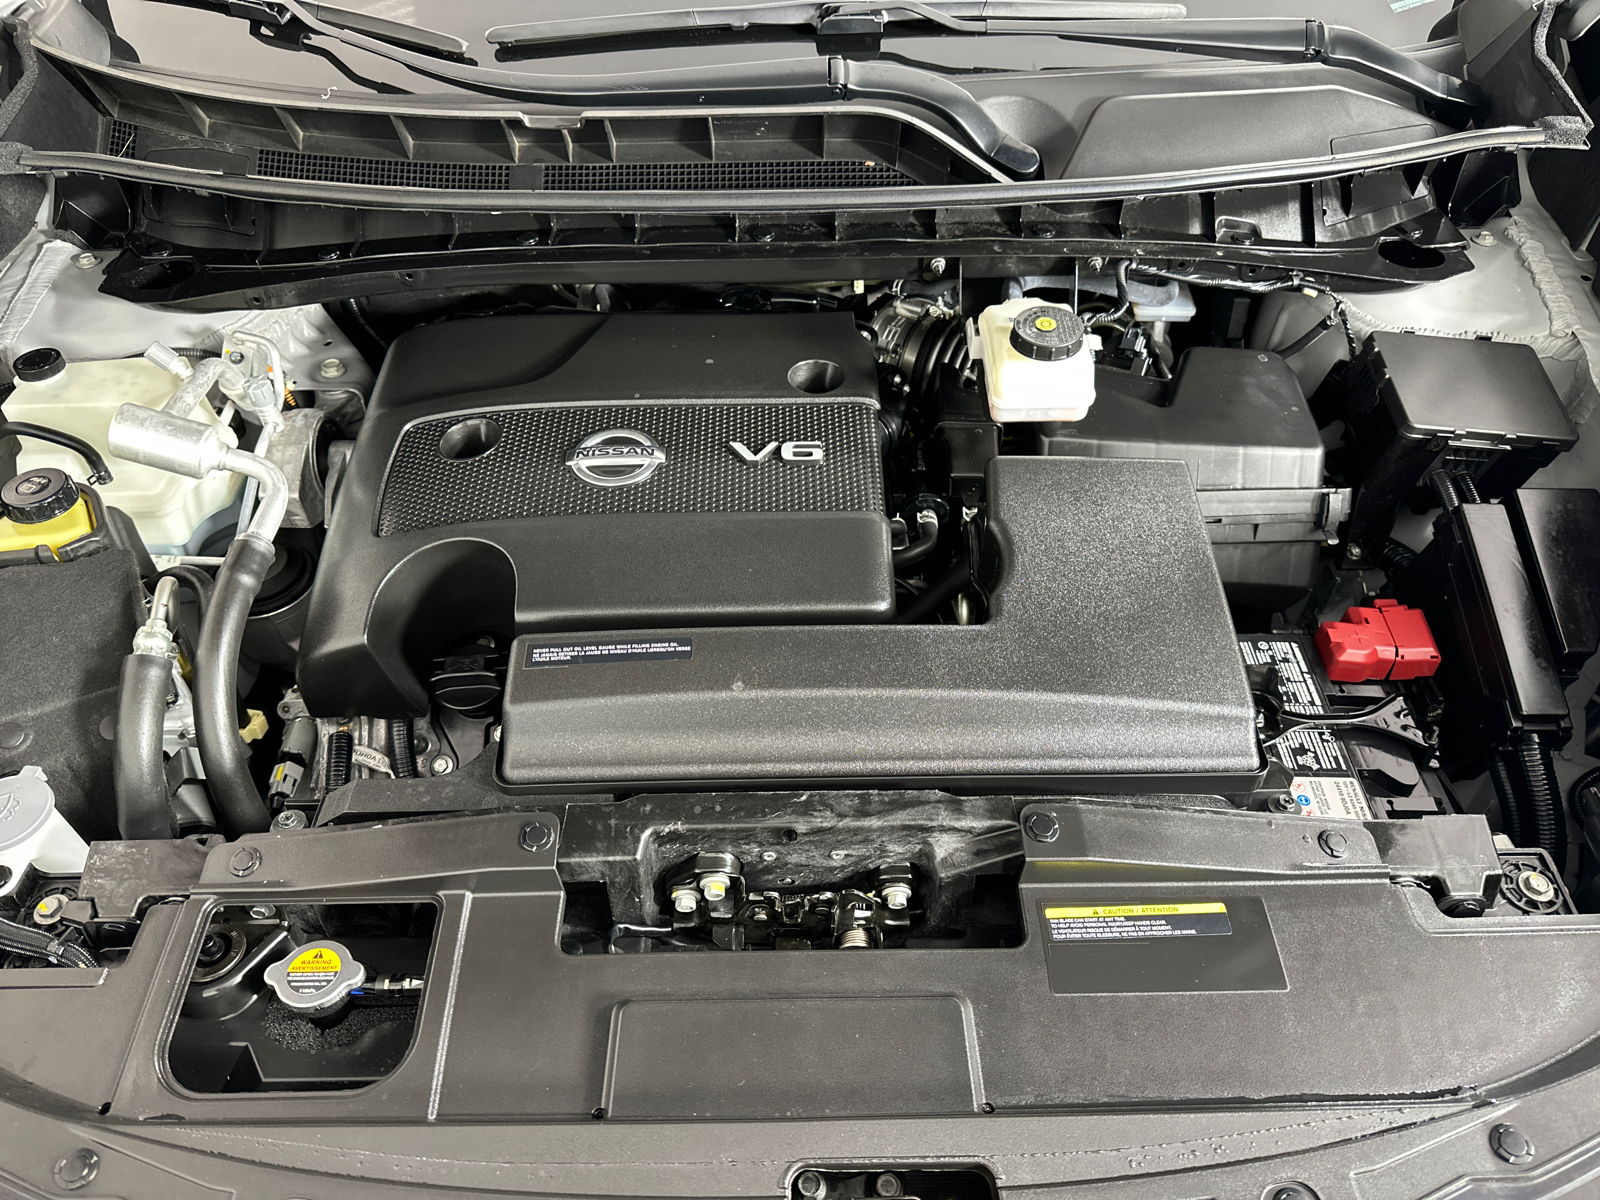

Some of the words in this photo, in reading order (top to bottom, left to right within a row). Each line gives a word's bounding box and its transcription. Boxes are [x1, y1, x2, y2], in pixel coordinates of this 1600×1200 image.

[575, 446, 655, 459] NISSAN
[729, 441, 824, 466] V6
[1103, 907, 1134, 915] CAUTION
